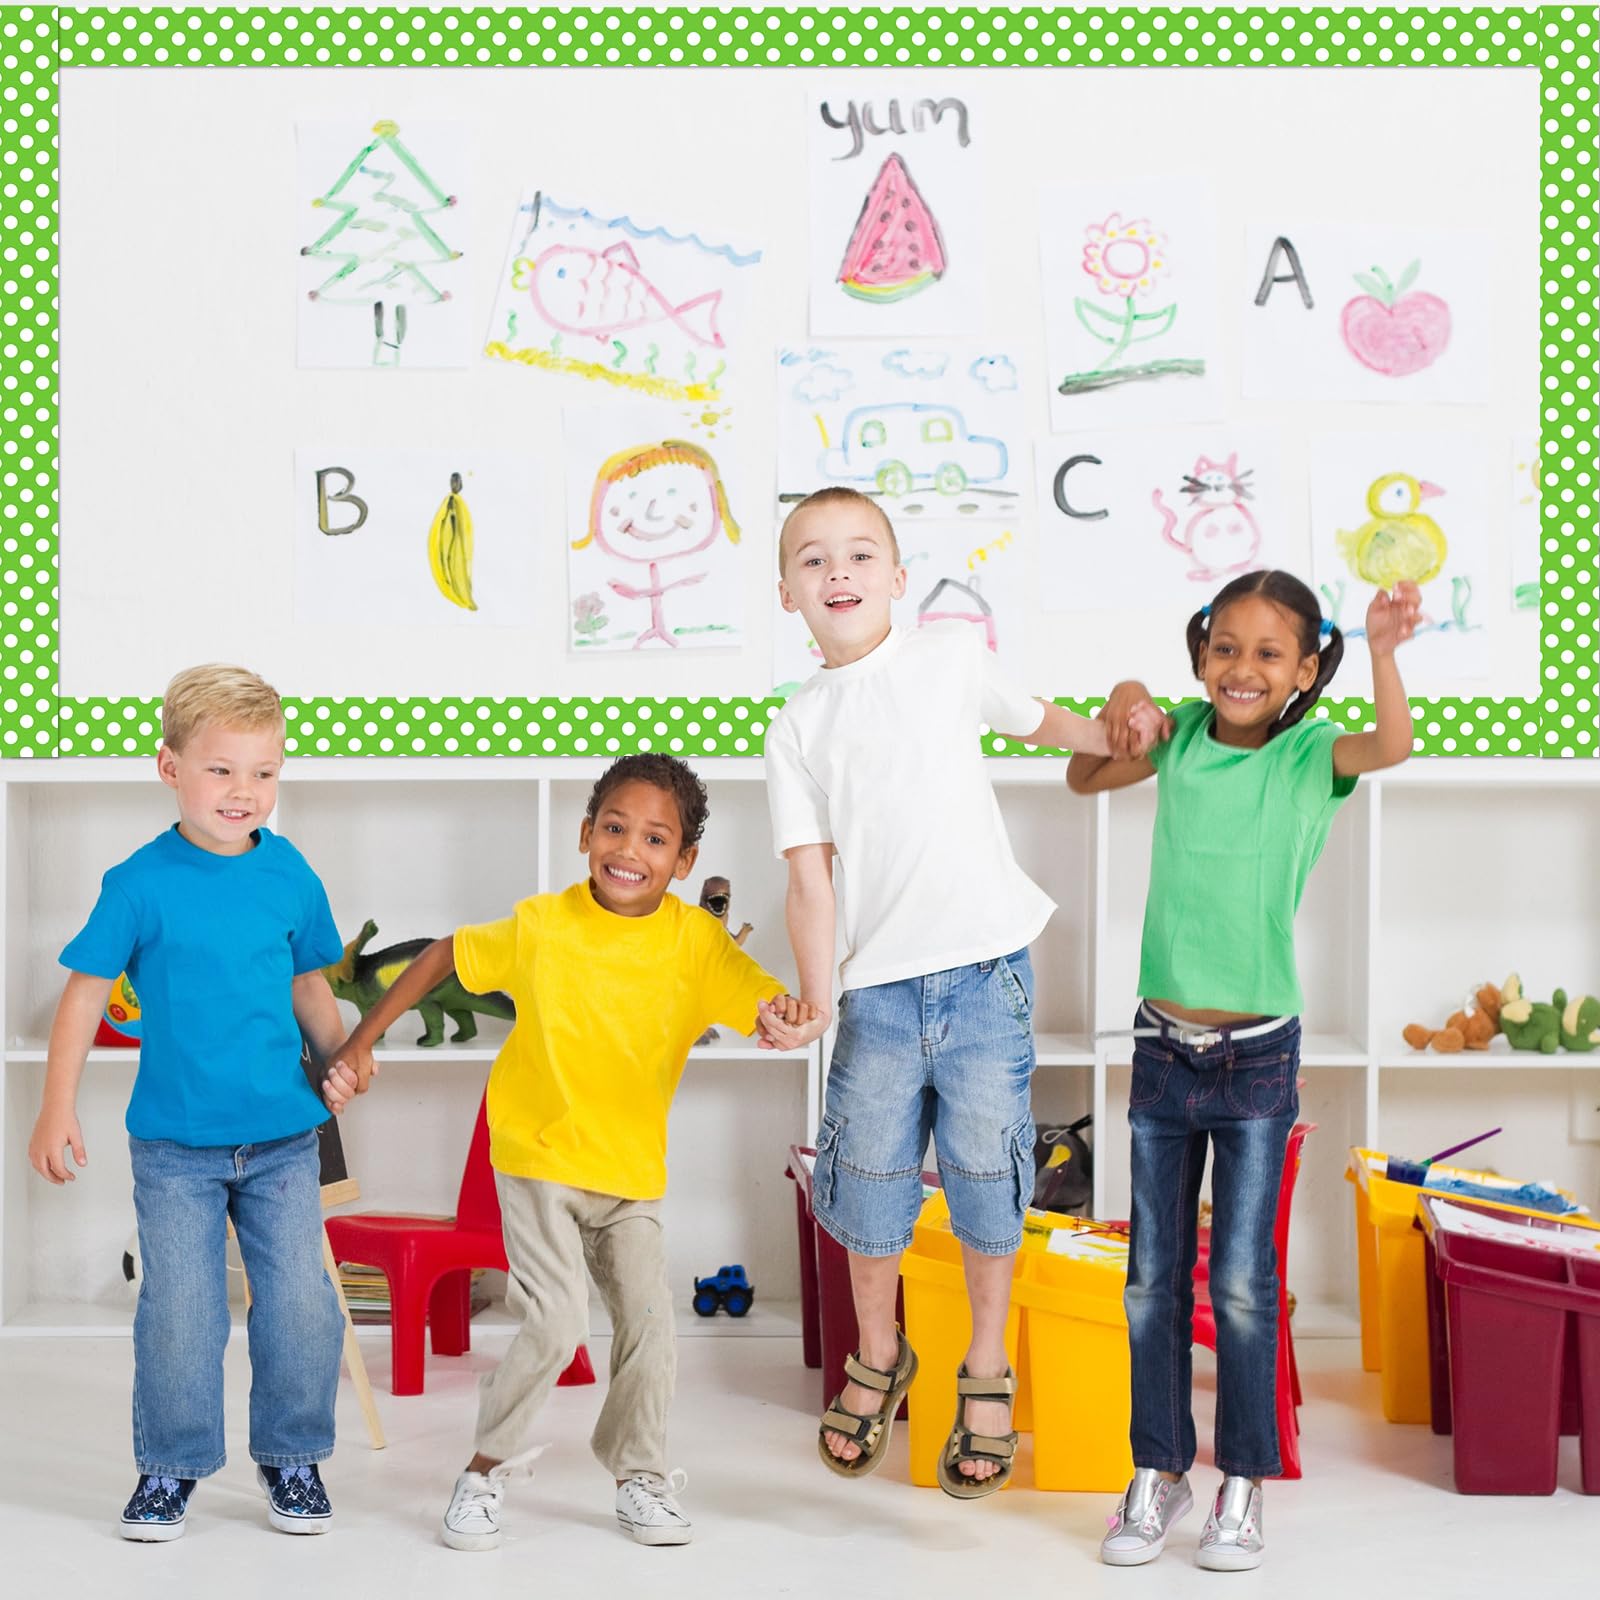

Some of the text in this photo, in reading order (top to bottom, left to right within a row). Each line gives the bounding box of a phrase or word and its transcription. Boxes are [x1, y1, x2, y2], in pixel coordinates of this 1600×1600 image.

[820, 98, 970, 161] yum
[1254, 236, 1314, 309] A
[315, 466, 368, 536] B
[1052, 454, 1109, 520] C
